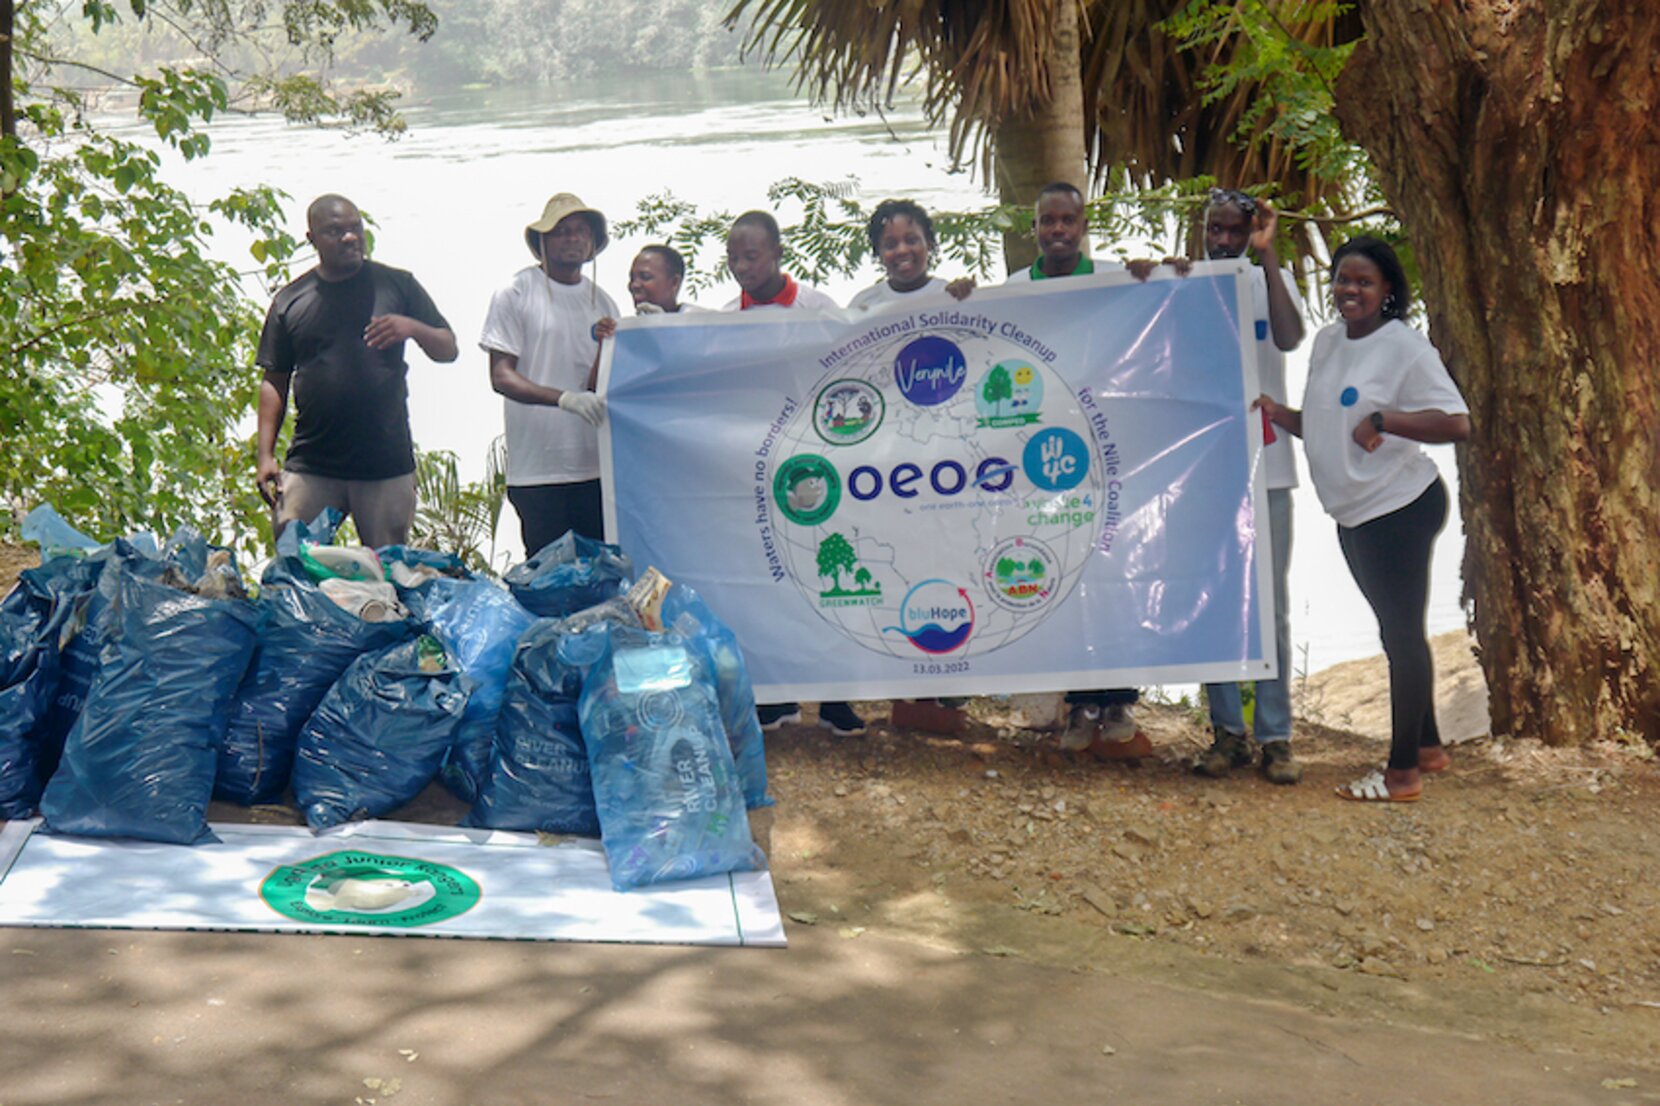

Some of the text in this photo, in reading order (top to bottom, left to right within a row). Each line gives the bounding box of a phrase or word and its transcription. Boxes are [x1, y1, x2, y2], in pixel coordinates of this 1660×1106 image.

[818, 311, 1057, 369] International Solidarity Cleanup
[1078, 387, 1122, 552] for the Nile Coalition
[754, 396, 797, 583] Waters have no borders!
[1026, 510, 1095, 528] change
[1007, 583, 1039, 597] ABN
[908, 606, 968, 622] bluHope
[912, 661, 970, 675] 13.03.2022
[676, 758, 700, 813] RIVER
[344, 855, 411, 867] Junior
